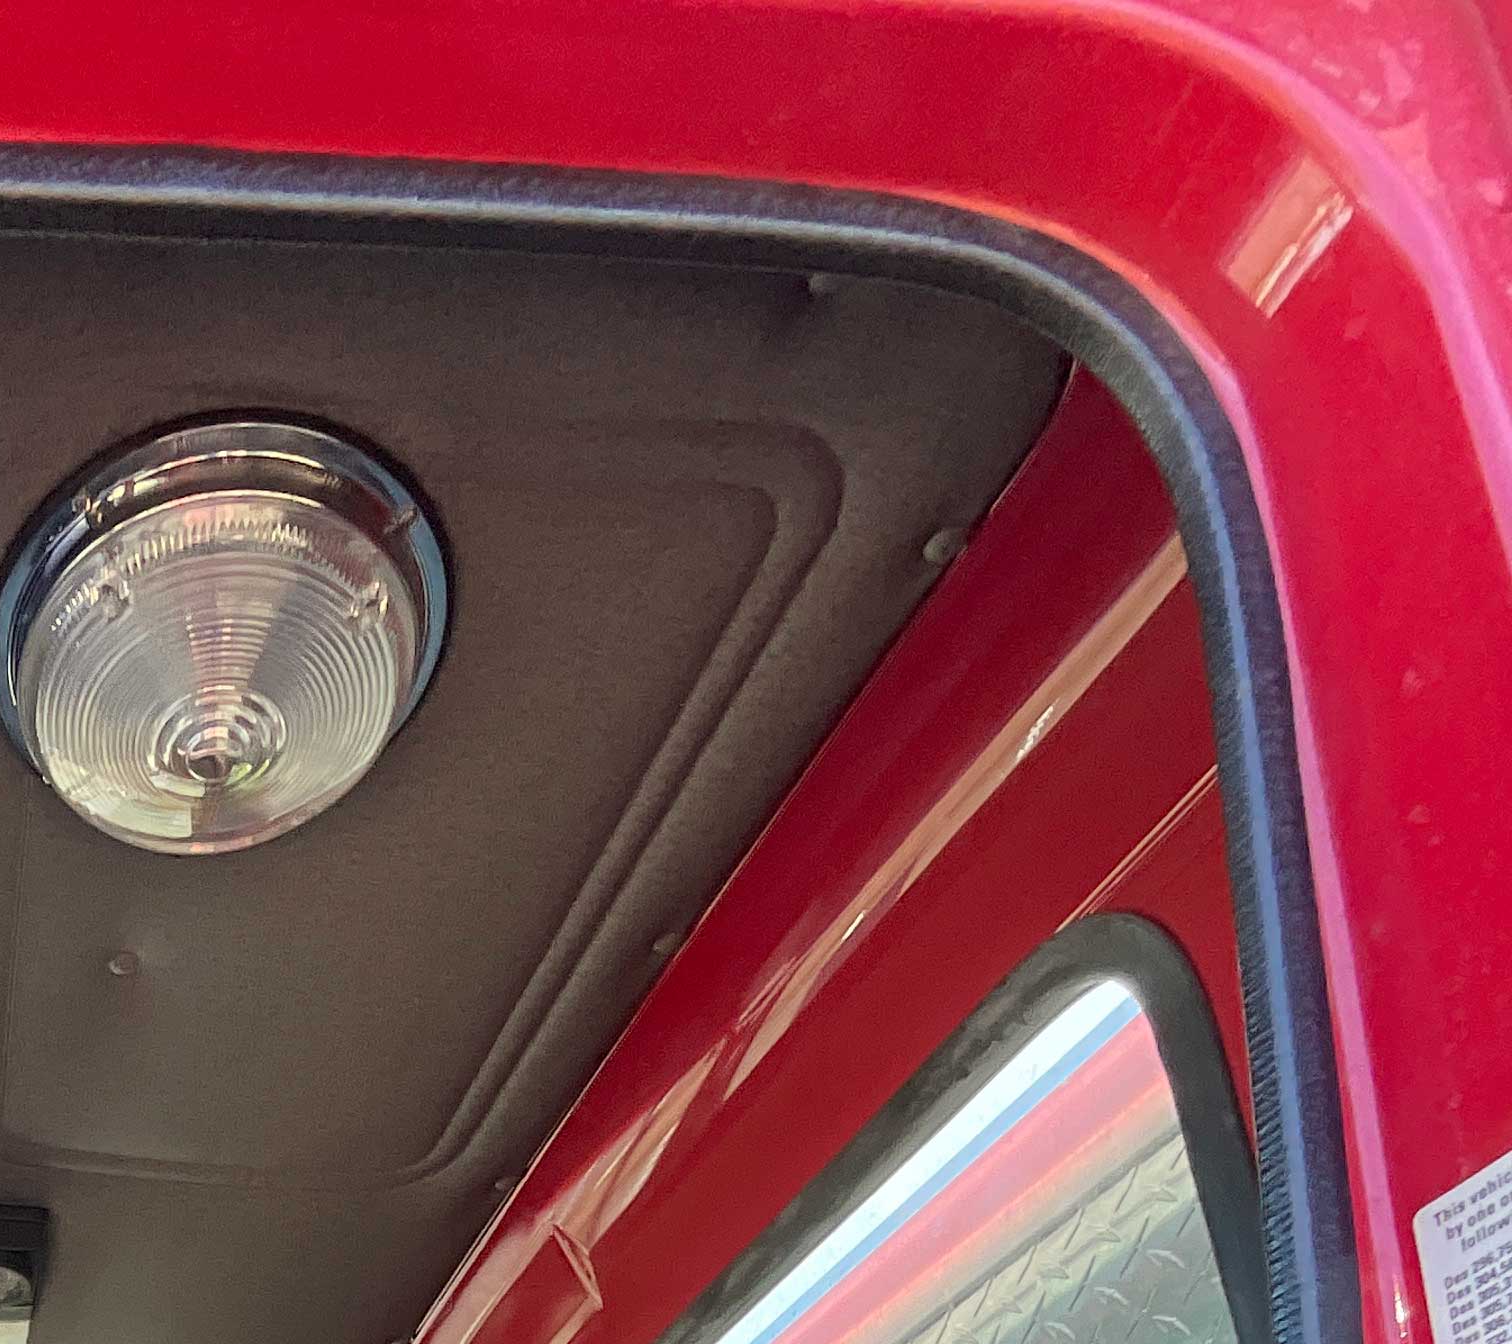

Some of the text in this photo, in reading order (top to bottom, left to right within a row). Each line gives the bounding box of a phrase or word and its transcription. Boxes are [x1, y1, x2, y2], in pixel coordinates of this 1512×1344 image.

[1434, 1200, 1465, 1227] This
[1447, 1222, 1464, 1240] by
[1468, 1203, 1495, 1227] one
